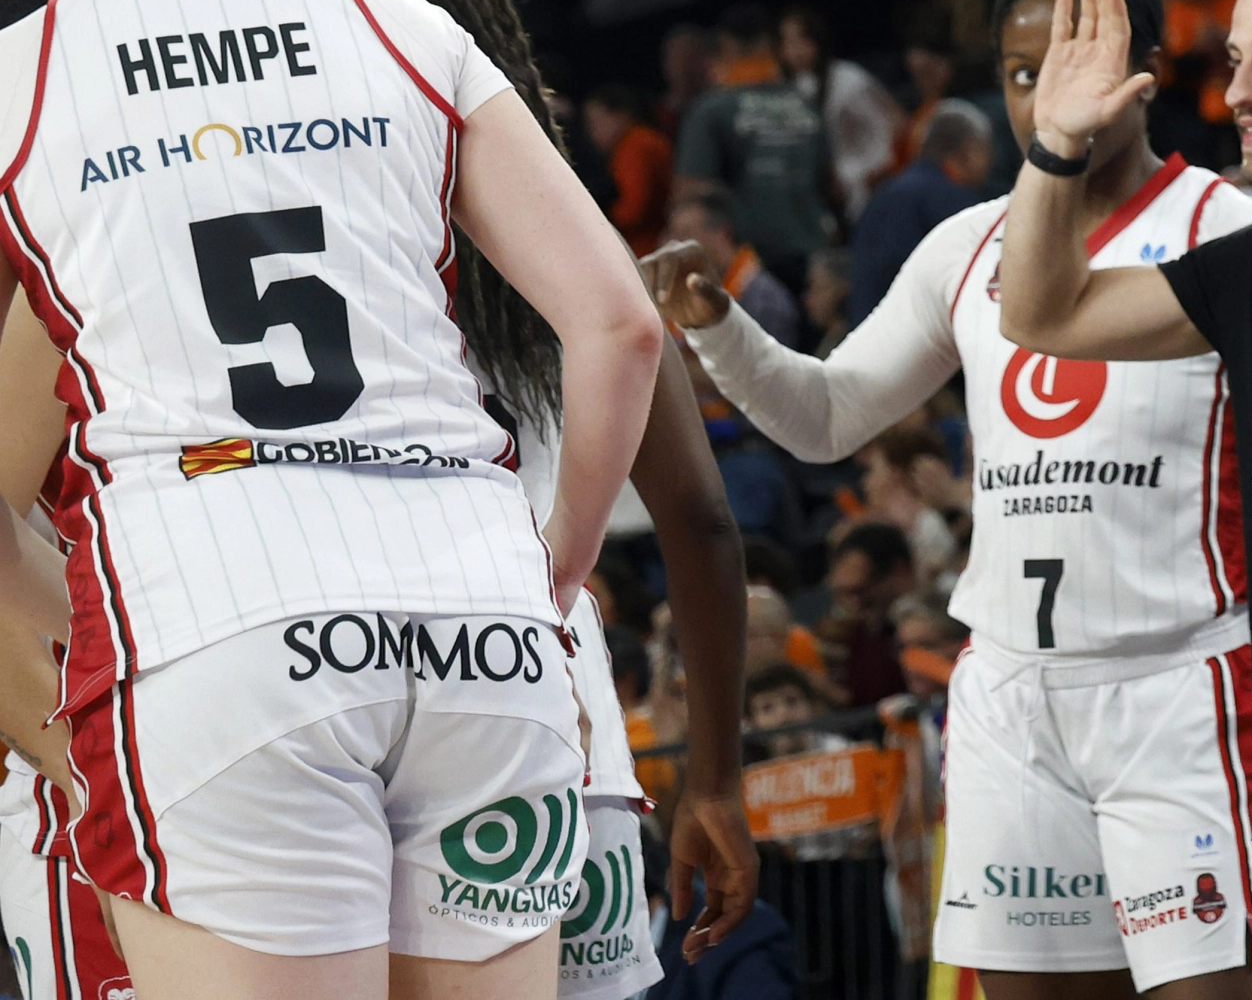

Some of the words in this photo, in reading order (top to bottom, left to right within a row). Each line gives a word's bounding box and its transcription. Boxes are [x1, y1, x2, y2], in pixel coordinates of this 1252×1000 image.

[116, 21, 317, 96] HEMPE
[80, 144, 147, 193] AIR
[156, 116, 391, 168] HORIZONT
[188, 205, 365, 431] 5
[979, 449, 1166, 491] asademont
[1003, 494, 1094, 517] ZARAGOZA
[1023, 558, 1064, 650] 7
[283, 611, 543, 684] SOMMOS
[428, 903, 499, 927] ÓPTICOS
[506, 917, 515, 928] &
[437, 873, 573, 914] YANGUAS
[1006, 910, 1092, 927] HOTELES
